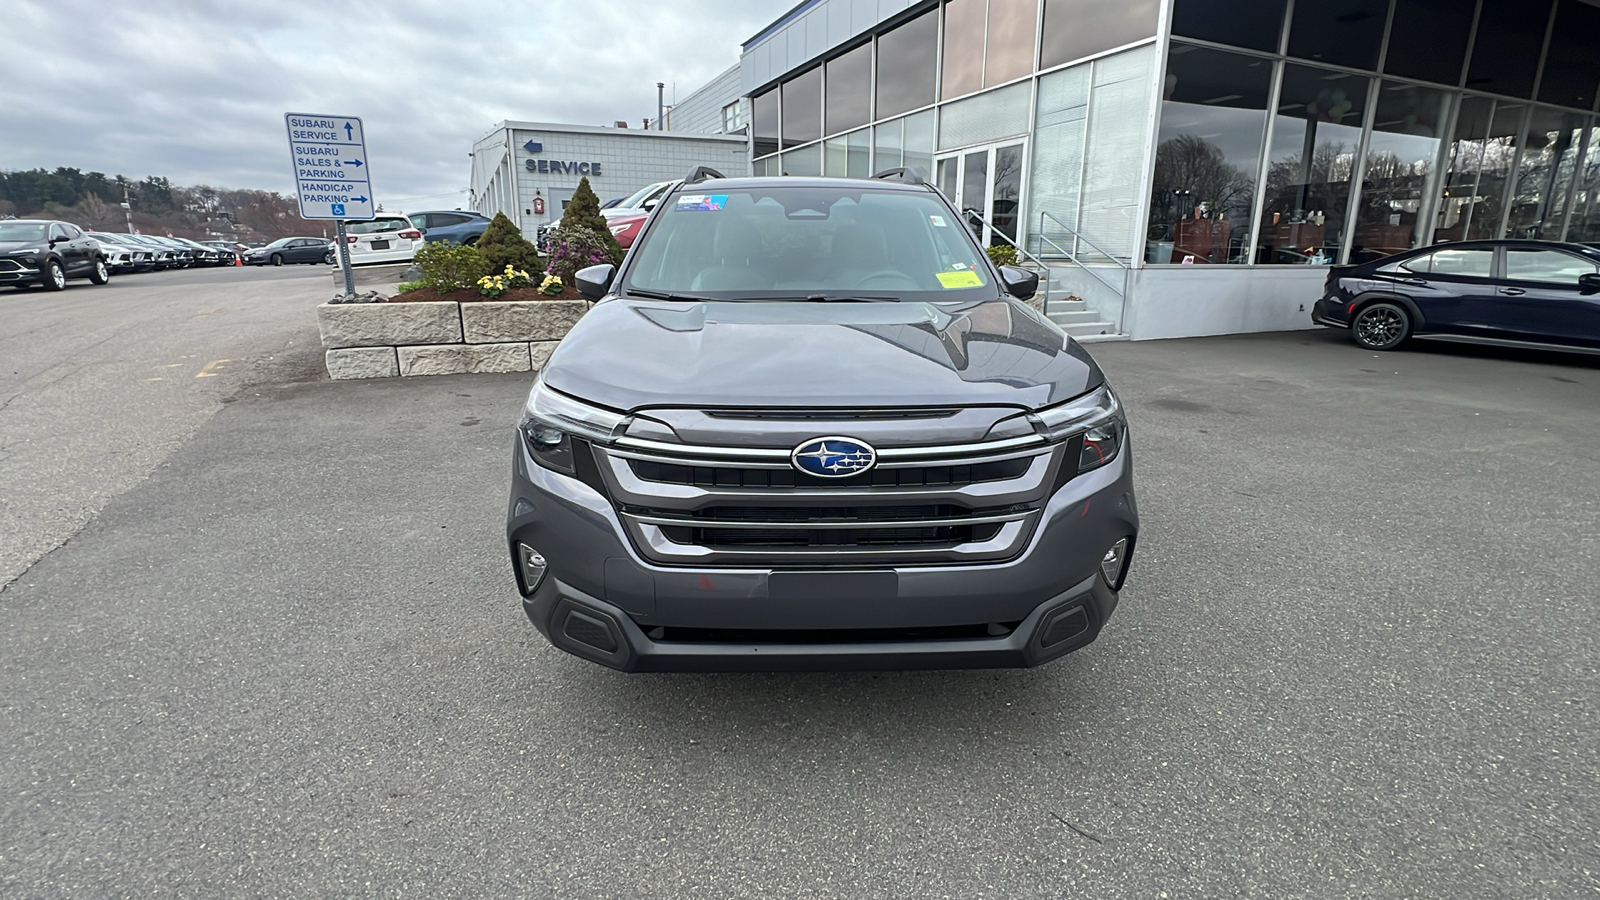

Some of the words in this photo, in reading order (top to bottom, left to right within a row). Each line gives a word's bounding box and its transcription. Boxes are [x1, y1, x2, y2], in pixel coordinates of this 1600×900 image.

[291, 118, 335, 129] SUBARU
[293, 130, 338, 140] SERVICE
[296, 146, 339, 156] SUBARU
[297, 157, 332, 167] SALES
[334, 159, 341, 167] &
[525, 158, 602, 176] SERVICE
[299, 169, 345, 179] PARKING
[301, 183, 354, 192] HANDICAP
[303, 194, 349, 203] PARKING
